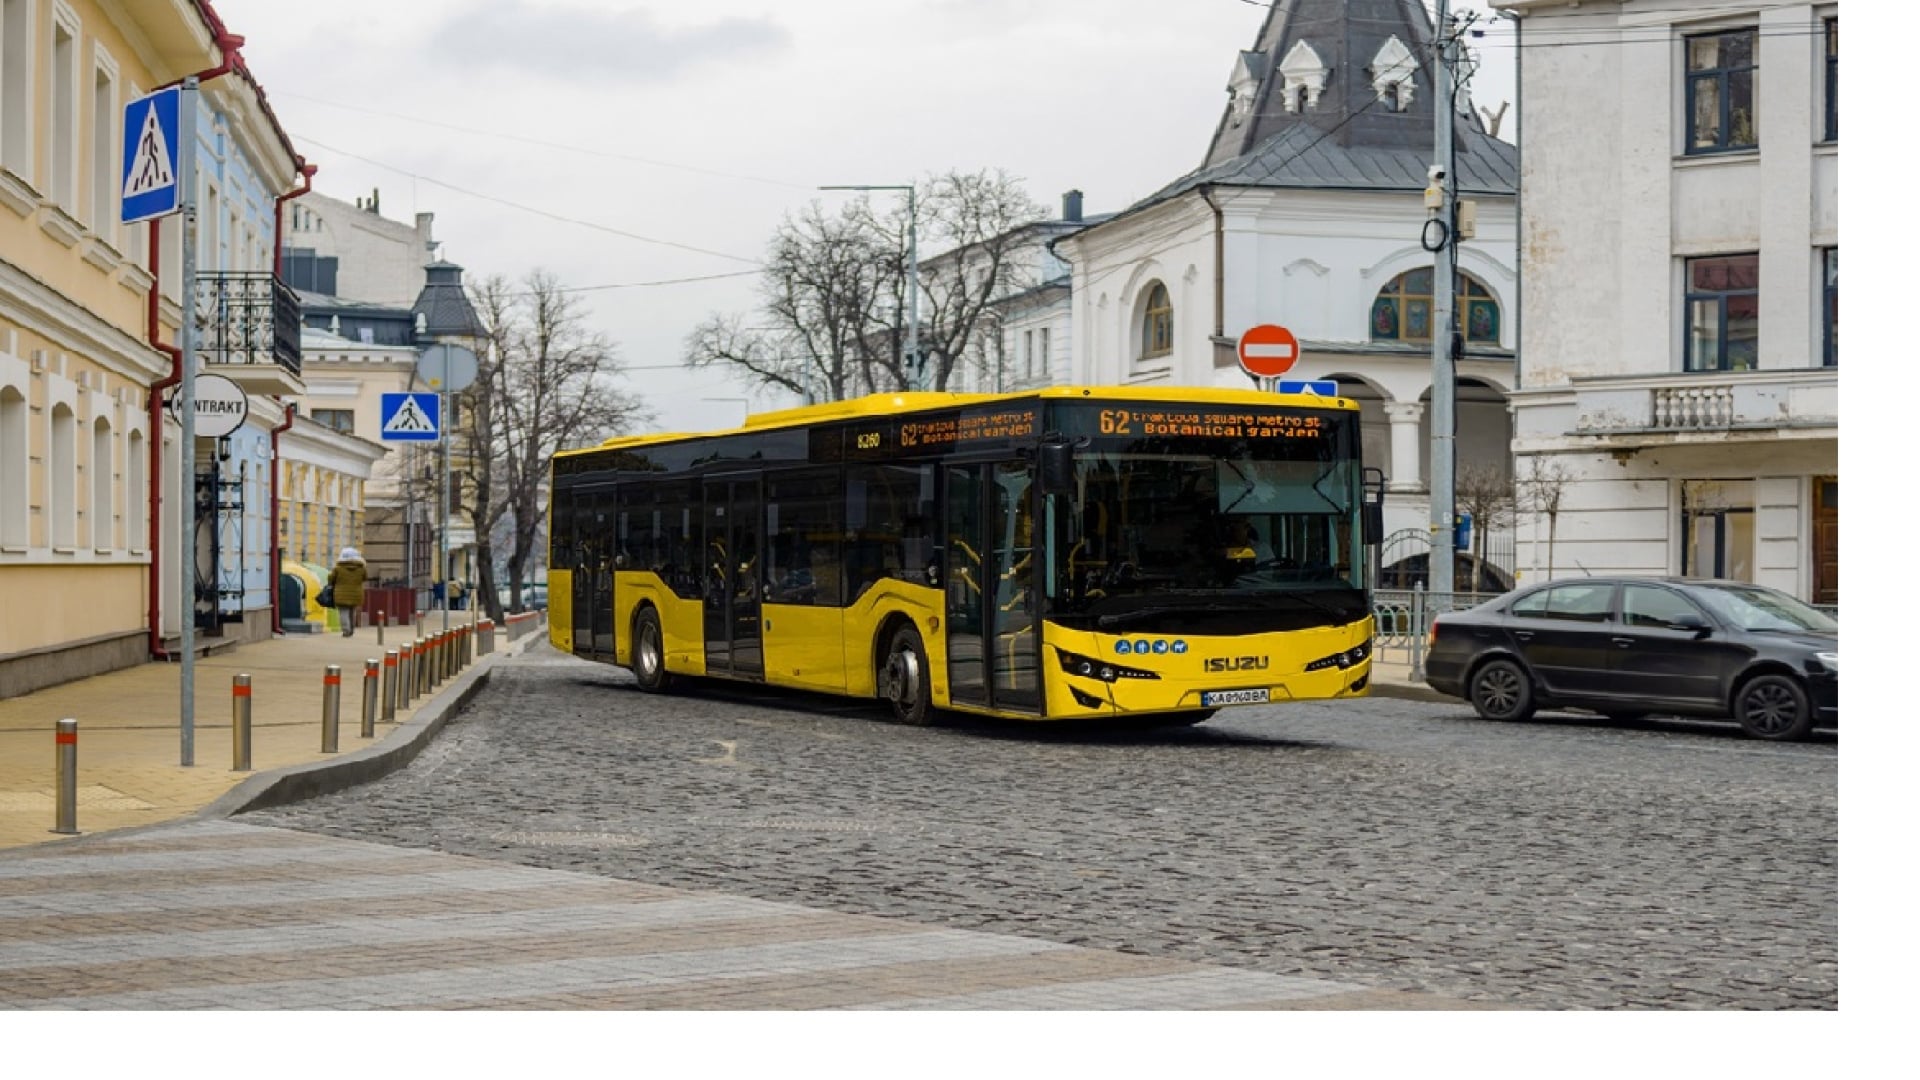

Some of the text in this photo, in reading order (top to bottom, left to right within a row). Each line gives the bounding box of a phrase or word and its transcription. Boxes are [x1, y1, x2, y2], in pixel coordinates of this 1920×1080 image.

[176, 399, 242, 414] KNTRAKT
[1100, 409, 1130, 434] 62
[1204, 414, 1254, 425] square
[901, 423, 917, 446] 62
[1144, 422, 1320, 438] Botanical garden
[1204, 655, 1269, 673] ISUZU
